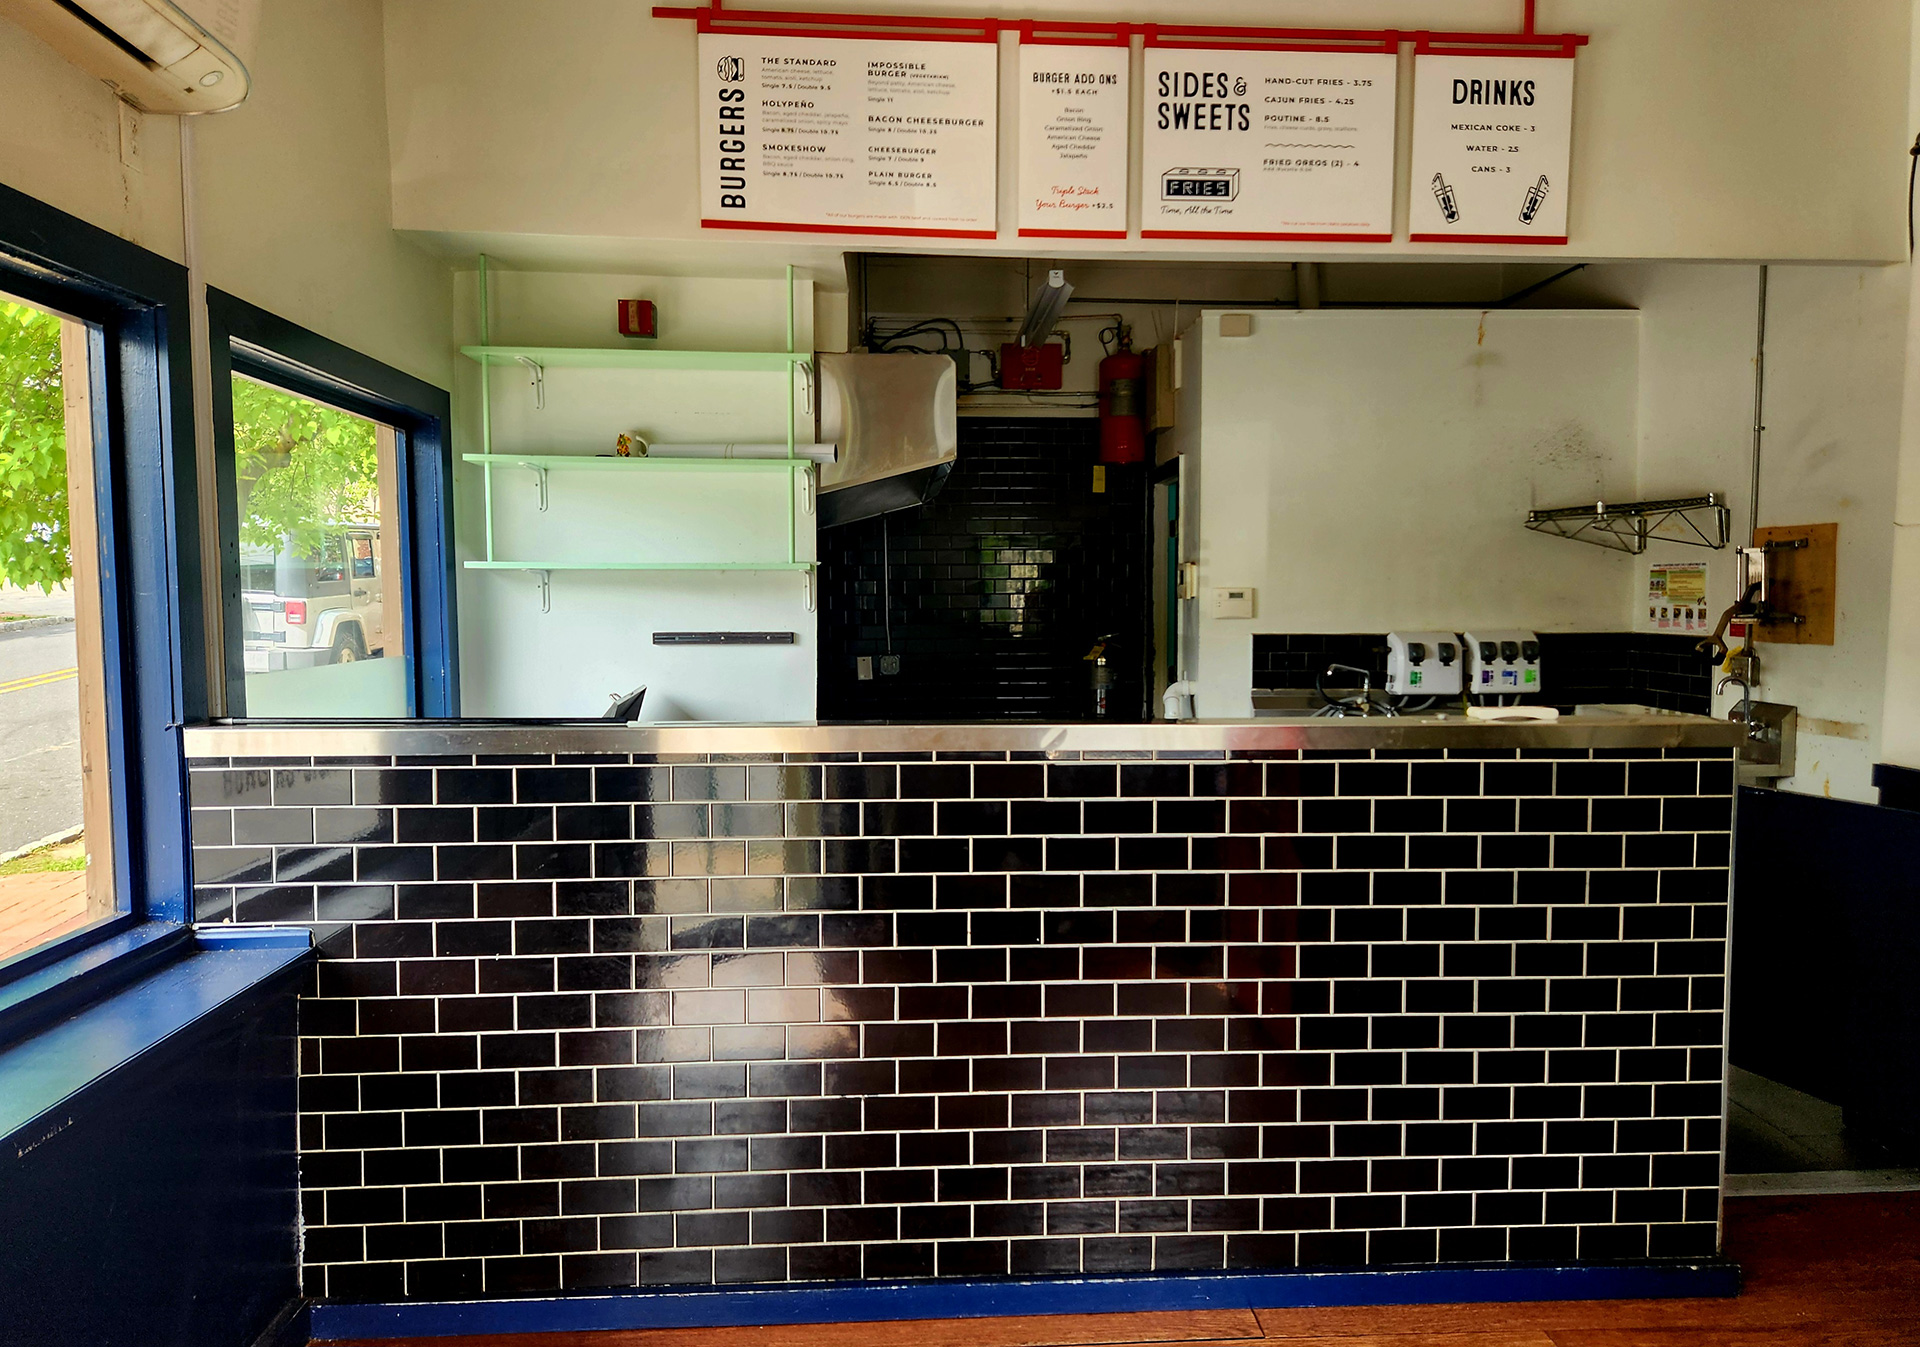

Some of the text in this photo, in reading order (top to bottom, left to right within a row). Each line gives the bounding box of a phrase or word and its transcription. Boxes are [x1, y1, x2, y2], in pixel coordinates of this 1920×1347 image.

[761, 57, 837, 67] THE STANDARD
[868, 61, 927, 70] IMPOSSIBLE
[868, 70, 907, 78] BURGER
[1033, 72, 1118, 85] BURGER ADD ONS
[1158, 71, 1248, 99] SIDES &
[1264, 78, 1314, 86] HAND-CUT
[1317, 78, 1344, 86] FRIES
[1353, 79, 1373, 87] 3.75
[1052, 88, 1098, 96] +$1.5 EACH
[1452, 79, 1536, 106] DRINKS
[762, 99, 815, 108] HOLYPEÑO
[1264, 96, 1295, 104] CAJUN
[1298, 97, 1326, 105] FRIES
[868, 115, 984, 127] BACON CHEESEBURGER
[1157, 102, 1250, 131] SWEETS
[1264, 114, 1306, 123] POUTINE
[1495, 124, 1521, 132] COKE
[1530, 125, 1536, 133] 3
[718, 88, 746, 208] BURGERS
[762, 143, 827, 153] SMOKESHOW
[868, 146, 937, 155] CHEESEBURGER
[1263, 159, 1292, 167] FRIED
[1295, 159, 1328, 167] OREOS
[1331, 160, 1344, 168] (2)
[763, 170, 781, 178] Single
[869, 170, 933, 179] PLAIN BURGER
[1051, 185, 1099, 197] Triple Stack
[1170, 181, 1227, 196] FRIES
[1036, 199, 1056, 211] Your
[1058, 199, 1089, 211] Burger
[1160, 205, 1234, 215] Time, All the Time
